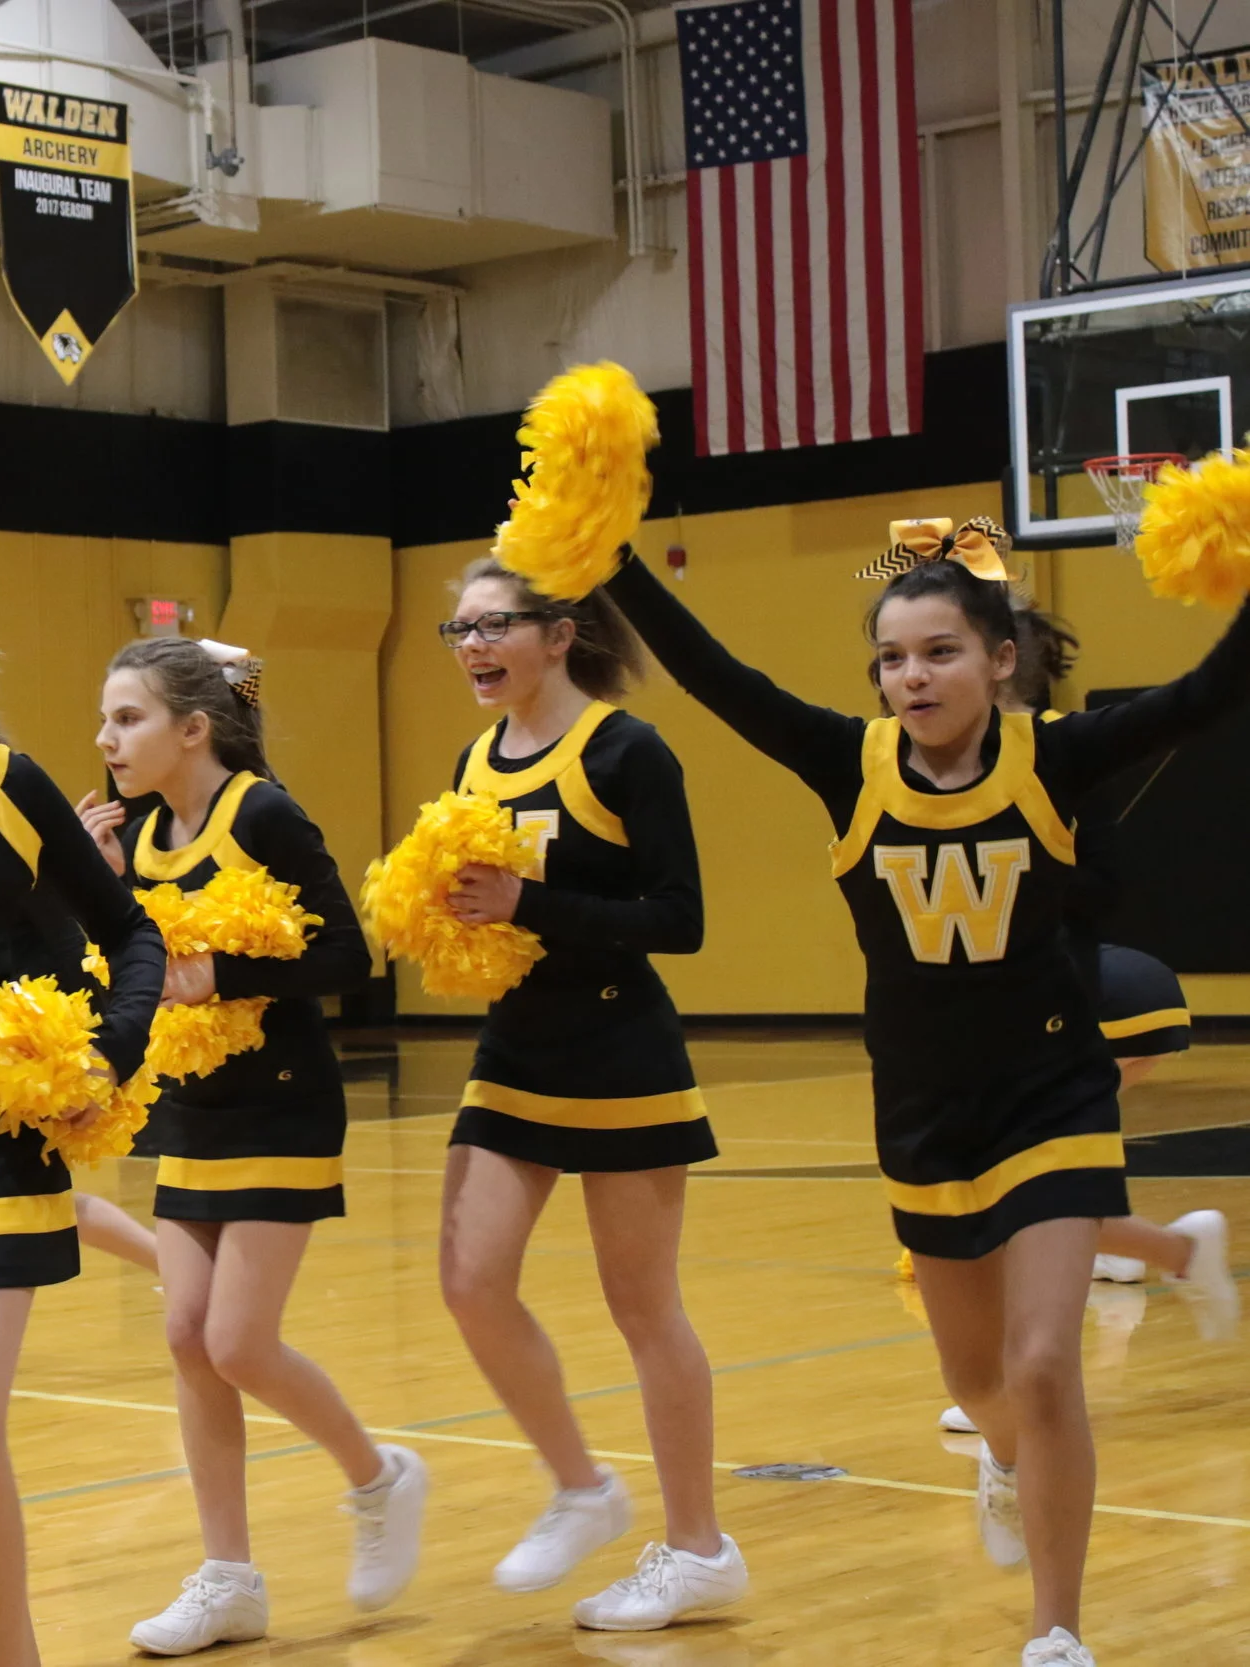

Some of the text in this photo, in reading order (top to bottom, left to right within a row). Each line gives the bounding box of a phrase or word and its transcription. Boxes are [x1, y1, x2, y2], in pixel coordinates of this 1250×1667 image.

[3, 88, 118, 137] WALDEN
[23, 138, 98, 166] ARCHERY
[15, 168, 112, 203] INAUGURAL TEAM
[36, 197, 94, 220] 2017 SEASON
[873, 837, 1030, 964] W
